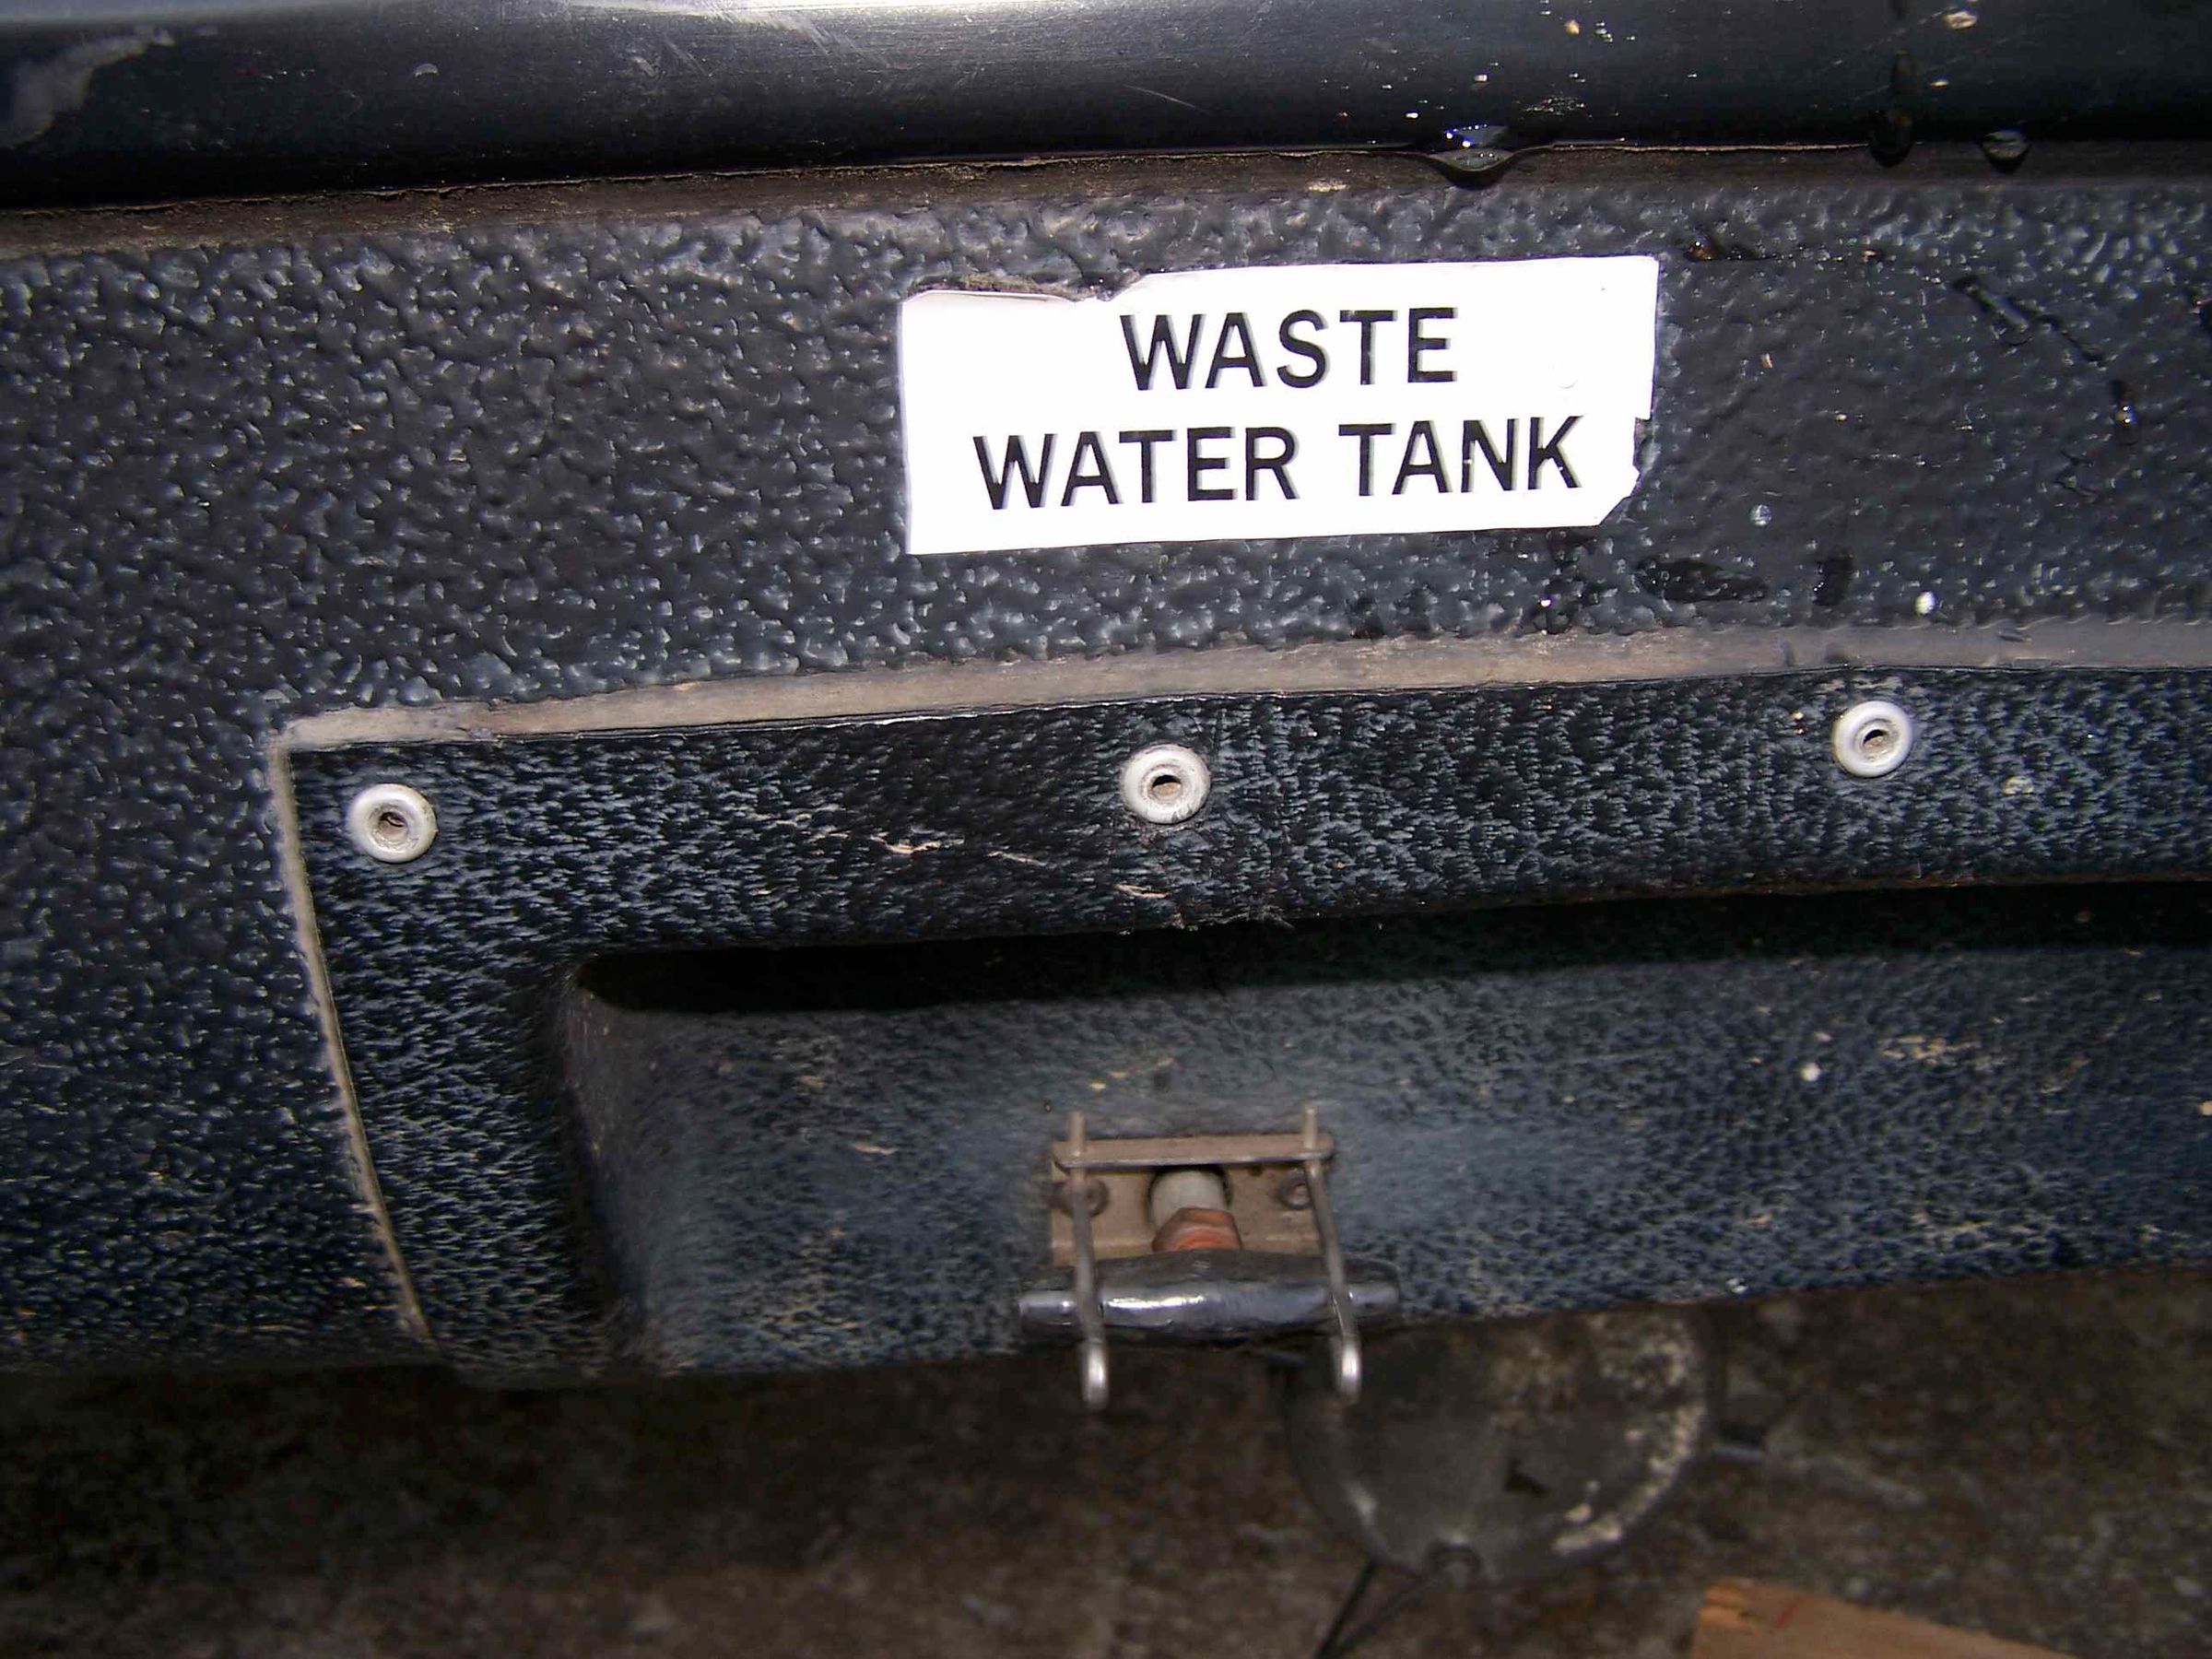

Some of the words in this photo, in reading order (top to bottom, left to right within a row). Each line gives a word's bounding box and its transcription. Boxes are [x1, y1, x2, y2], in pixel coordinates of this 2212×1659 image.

[1120, 307, 1458, 390] WASTE
[973, 426, 1299, 511] WATER
[1338, 416, 1583, 497] TANK
